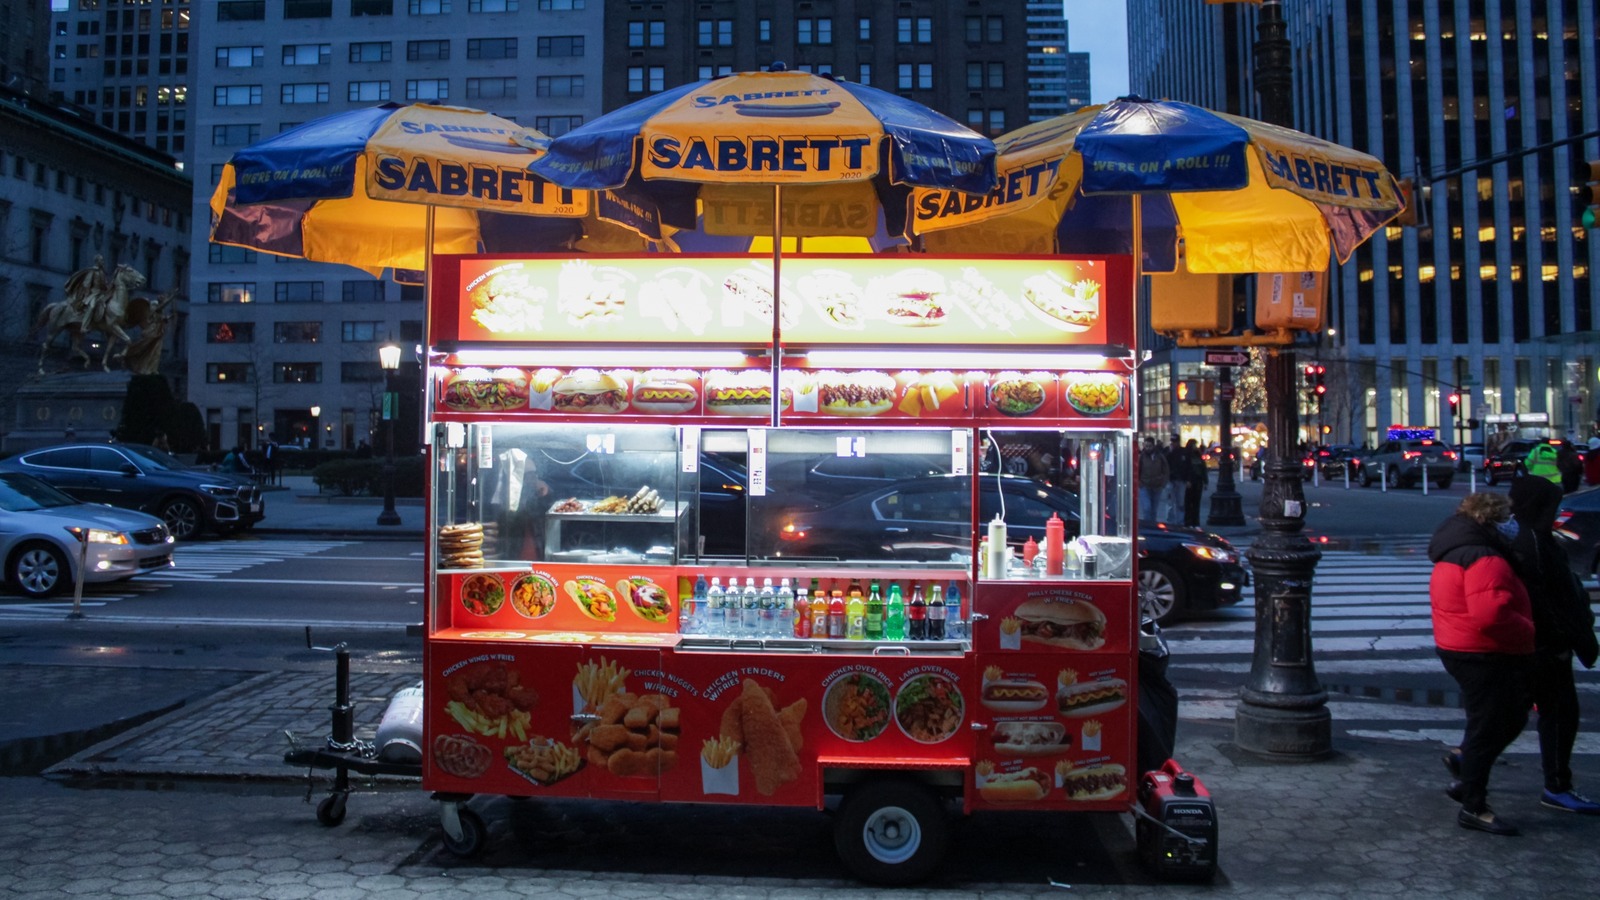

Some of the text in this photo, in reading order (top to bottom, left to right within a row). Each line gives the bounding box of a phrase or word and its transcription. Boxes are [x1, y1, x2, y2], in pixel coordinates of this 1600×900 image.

[692, 89, 831, 108] SABRETT
[648, 134, 871, 171] SABRETT
[1093, 155, 1231, 173] WE'RE ON A ROLL !!!
[242, 165, 344, 184] WE'RE ON A ROLL !!!
[553, 206, 574, 214] 2020
[466, 273, 487, 292] CHICKEN
[536, 570, 551, 579] LAMB
[550, 577, 560, 588] MIX
[1027, 590, 1048, 598] PHILLY
[1074, 591, 1093, 601] STEAK
[1055, 596, 1074, 605] FRIES
[816, 616, 825, 626] G
[854, 616, 863, 627] G
[442, 660, 468, 677] CHICKEN
[468, 654, 489, 664] WINGS
[898, 665, 961, 683] LAMB OVER RICE
[634, 669, 699, 697] CHICKEN NUGGETS
[702, 667, 786, 699] CHICKEN TENDERS
[821, 664, 895, 689] CHICKEN OVER RICE
[644, 681, 679, 698] W/FRIES
[709, 677, 740, 701] W/FRIES
